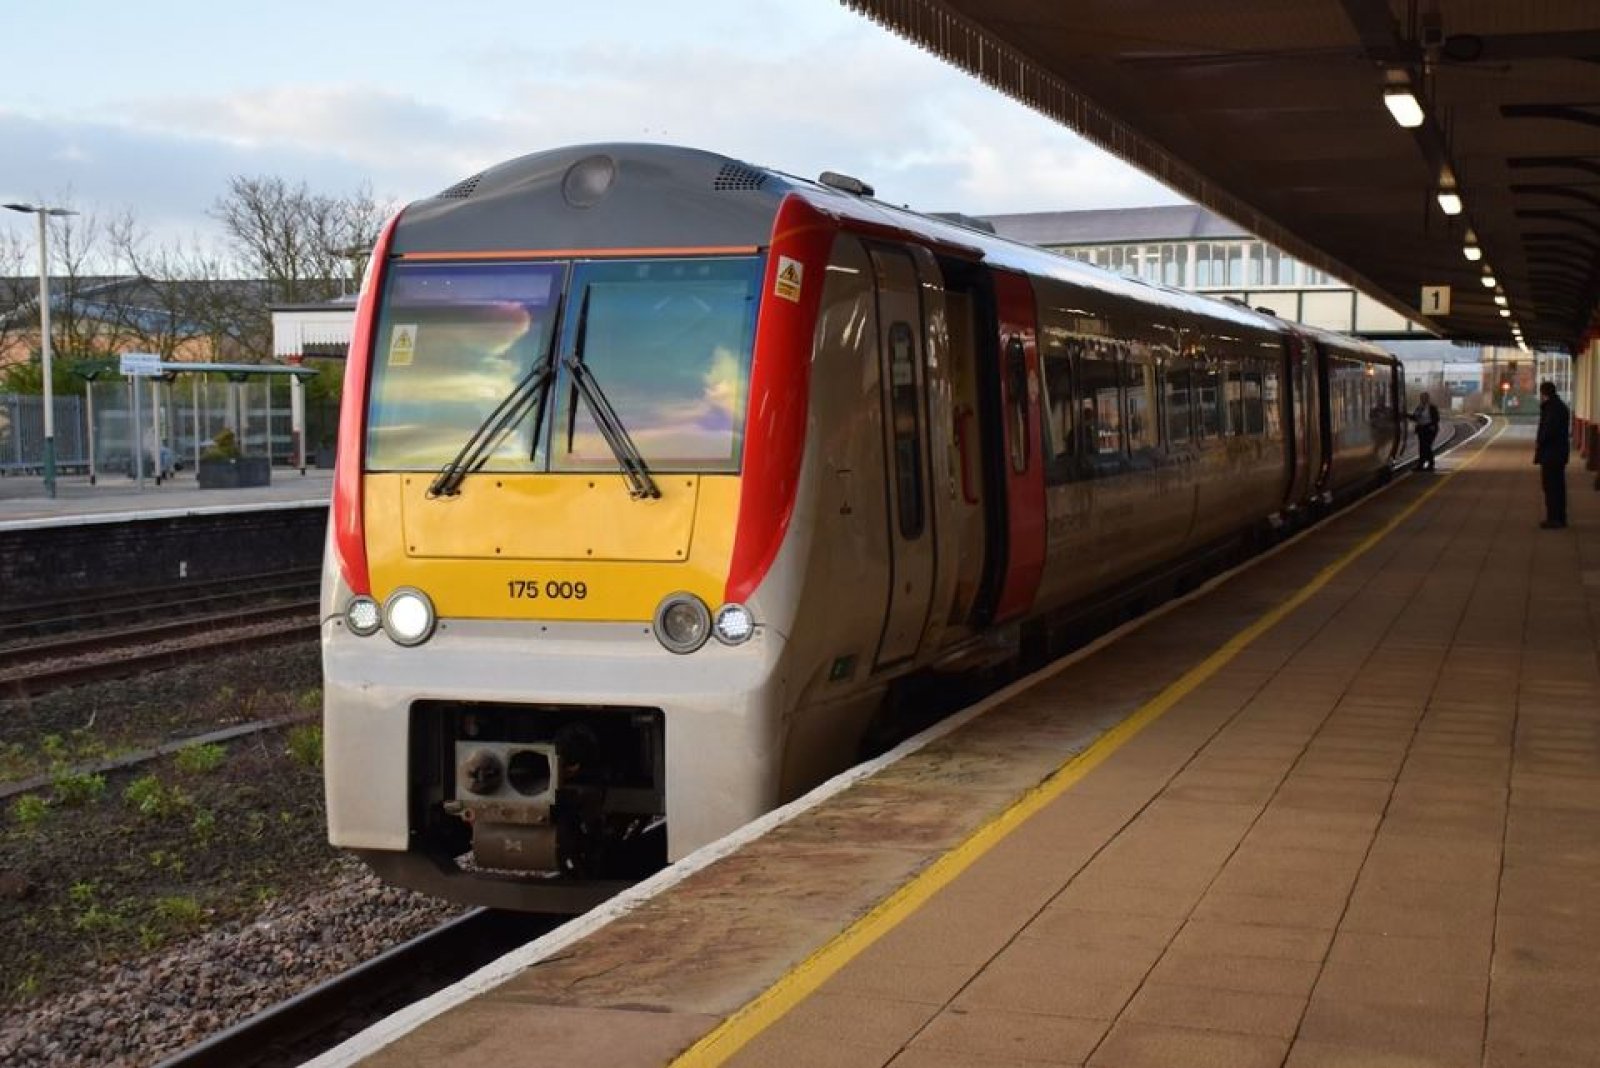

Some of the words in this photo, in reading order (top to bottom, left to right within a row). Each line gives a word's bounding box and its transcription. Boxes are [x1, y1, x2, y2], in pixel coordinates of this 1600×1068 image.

[1431, 290, 1439, 310] 1
[508, 581, 538, 599] 175
[546, 581, 587, 600] 009
